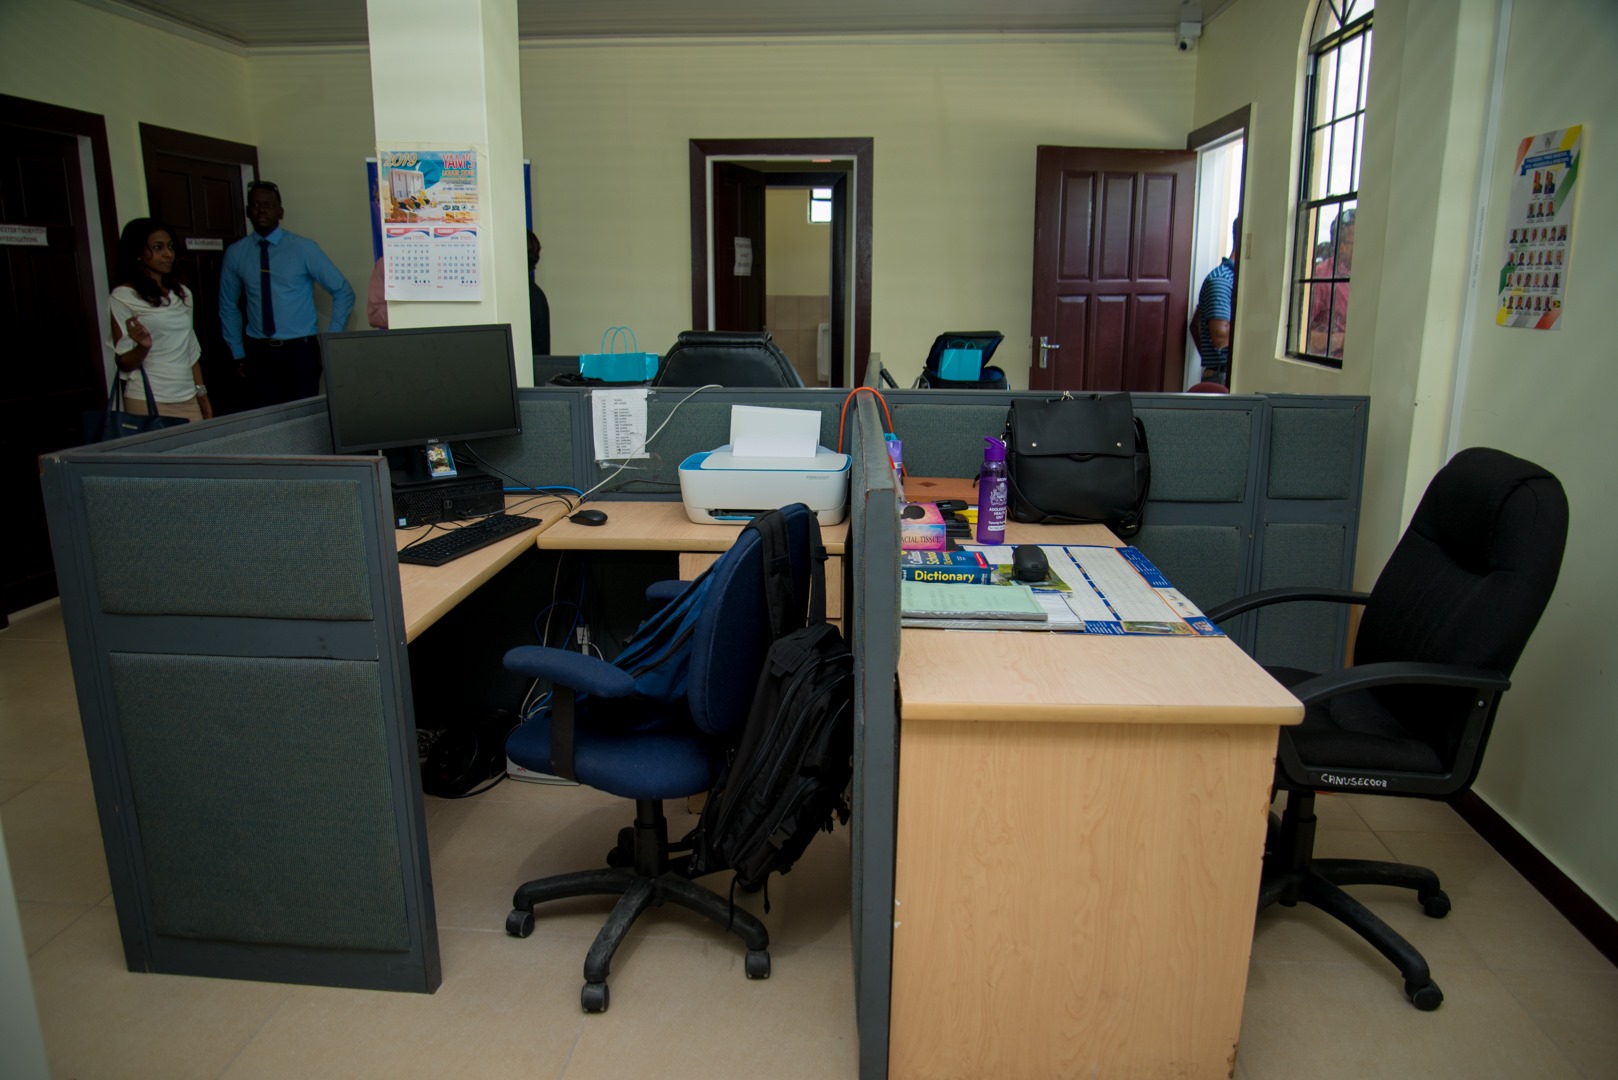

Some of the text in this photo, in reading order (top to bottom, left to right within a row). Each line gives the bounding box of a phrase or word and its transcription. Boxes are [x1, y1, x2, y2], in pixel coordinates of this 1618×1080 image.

[384, 152, 418, 166] 2019
[442, 153, 475, 169] YAM'S
[914, 570, 974, 583] Dictionary
